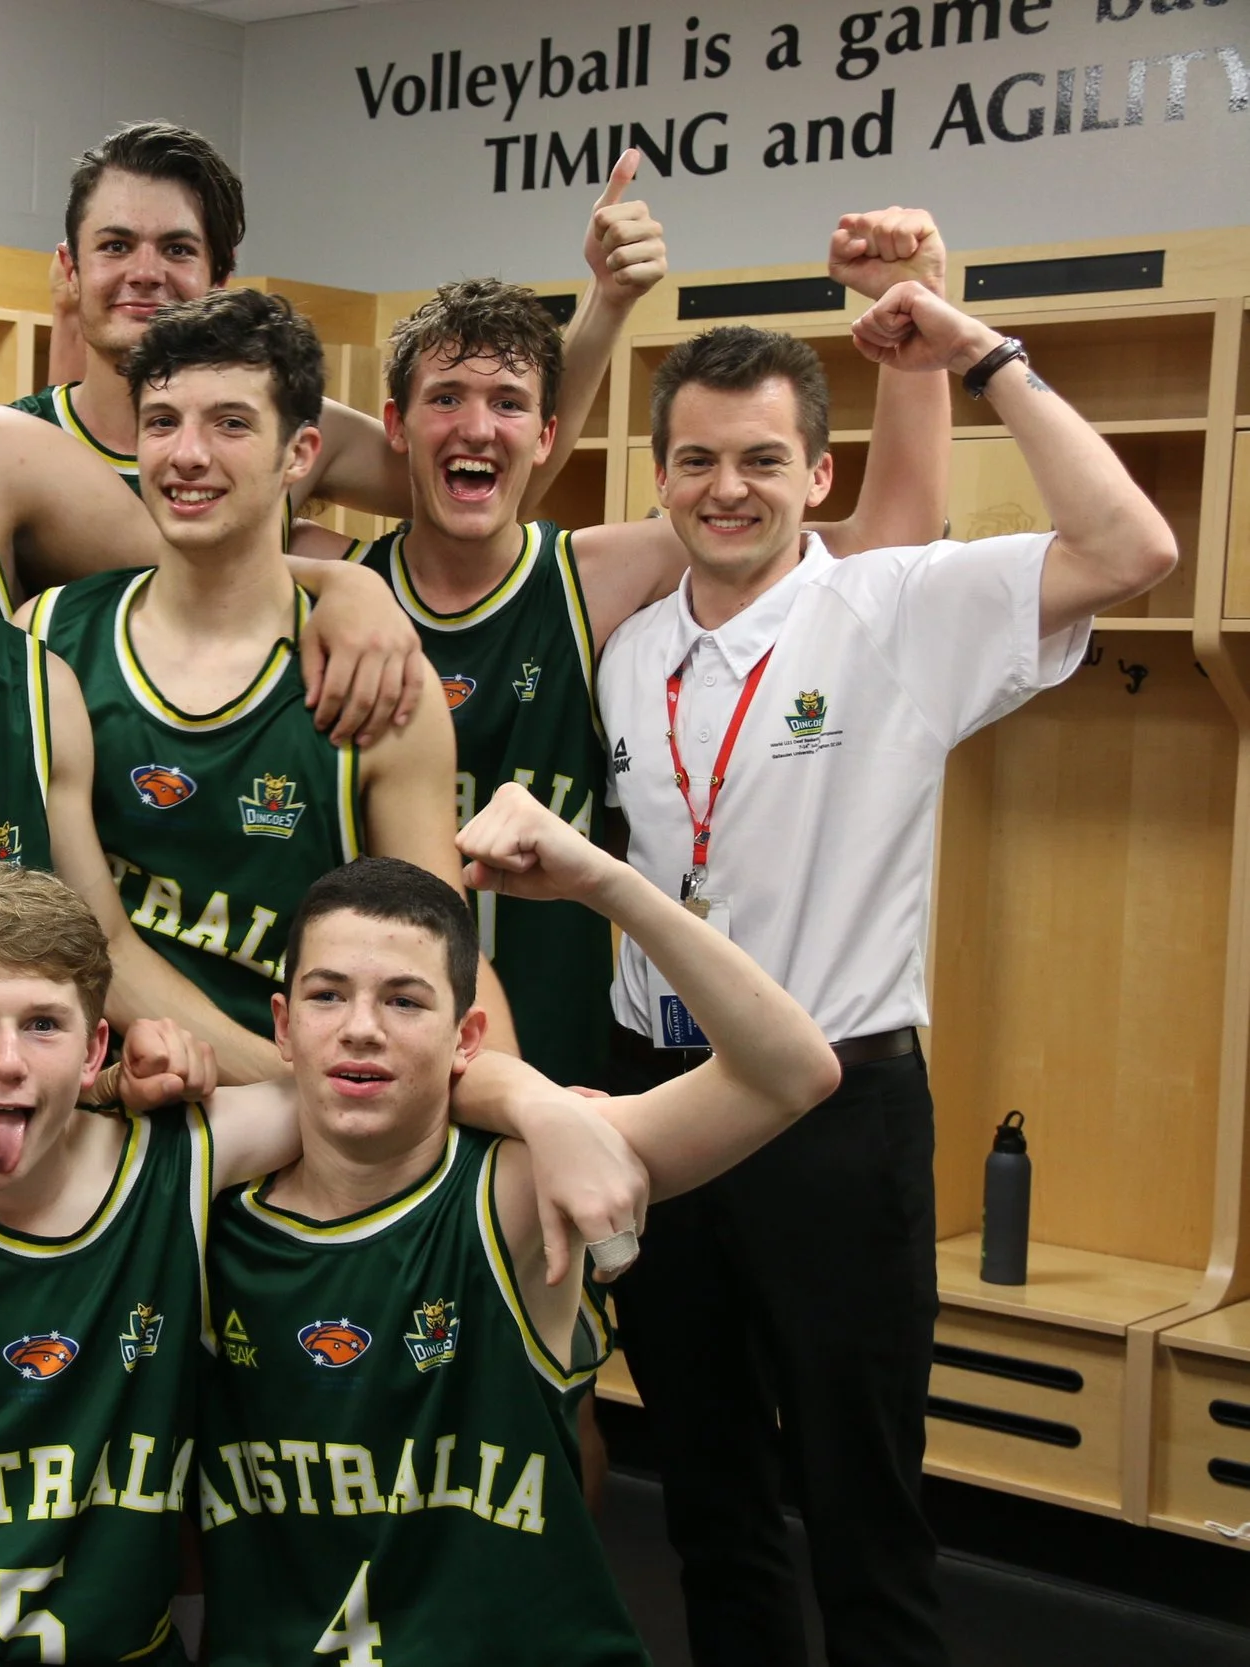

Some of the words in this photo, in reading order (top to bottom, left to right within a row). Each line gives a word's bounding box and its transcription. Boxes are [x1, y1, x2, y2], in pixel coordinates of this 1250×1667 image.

[356, 24, 651, 121] Volleyball
[683, 16, 731, 80] is
[766, 23, 801, 71] a
[836, 0, 1053, 81] game
[484, 111, 728, 193] TIMING
[763, 88, 896, 168] and
[790, 719, 823, 731] DINGOE
[245, 808, 295, 828] DINGOES
[313, 1560, 383, 1667] 4
